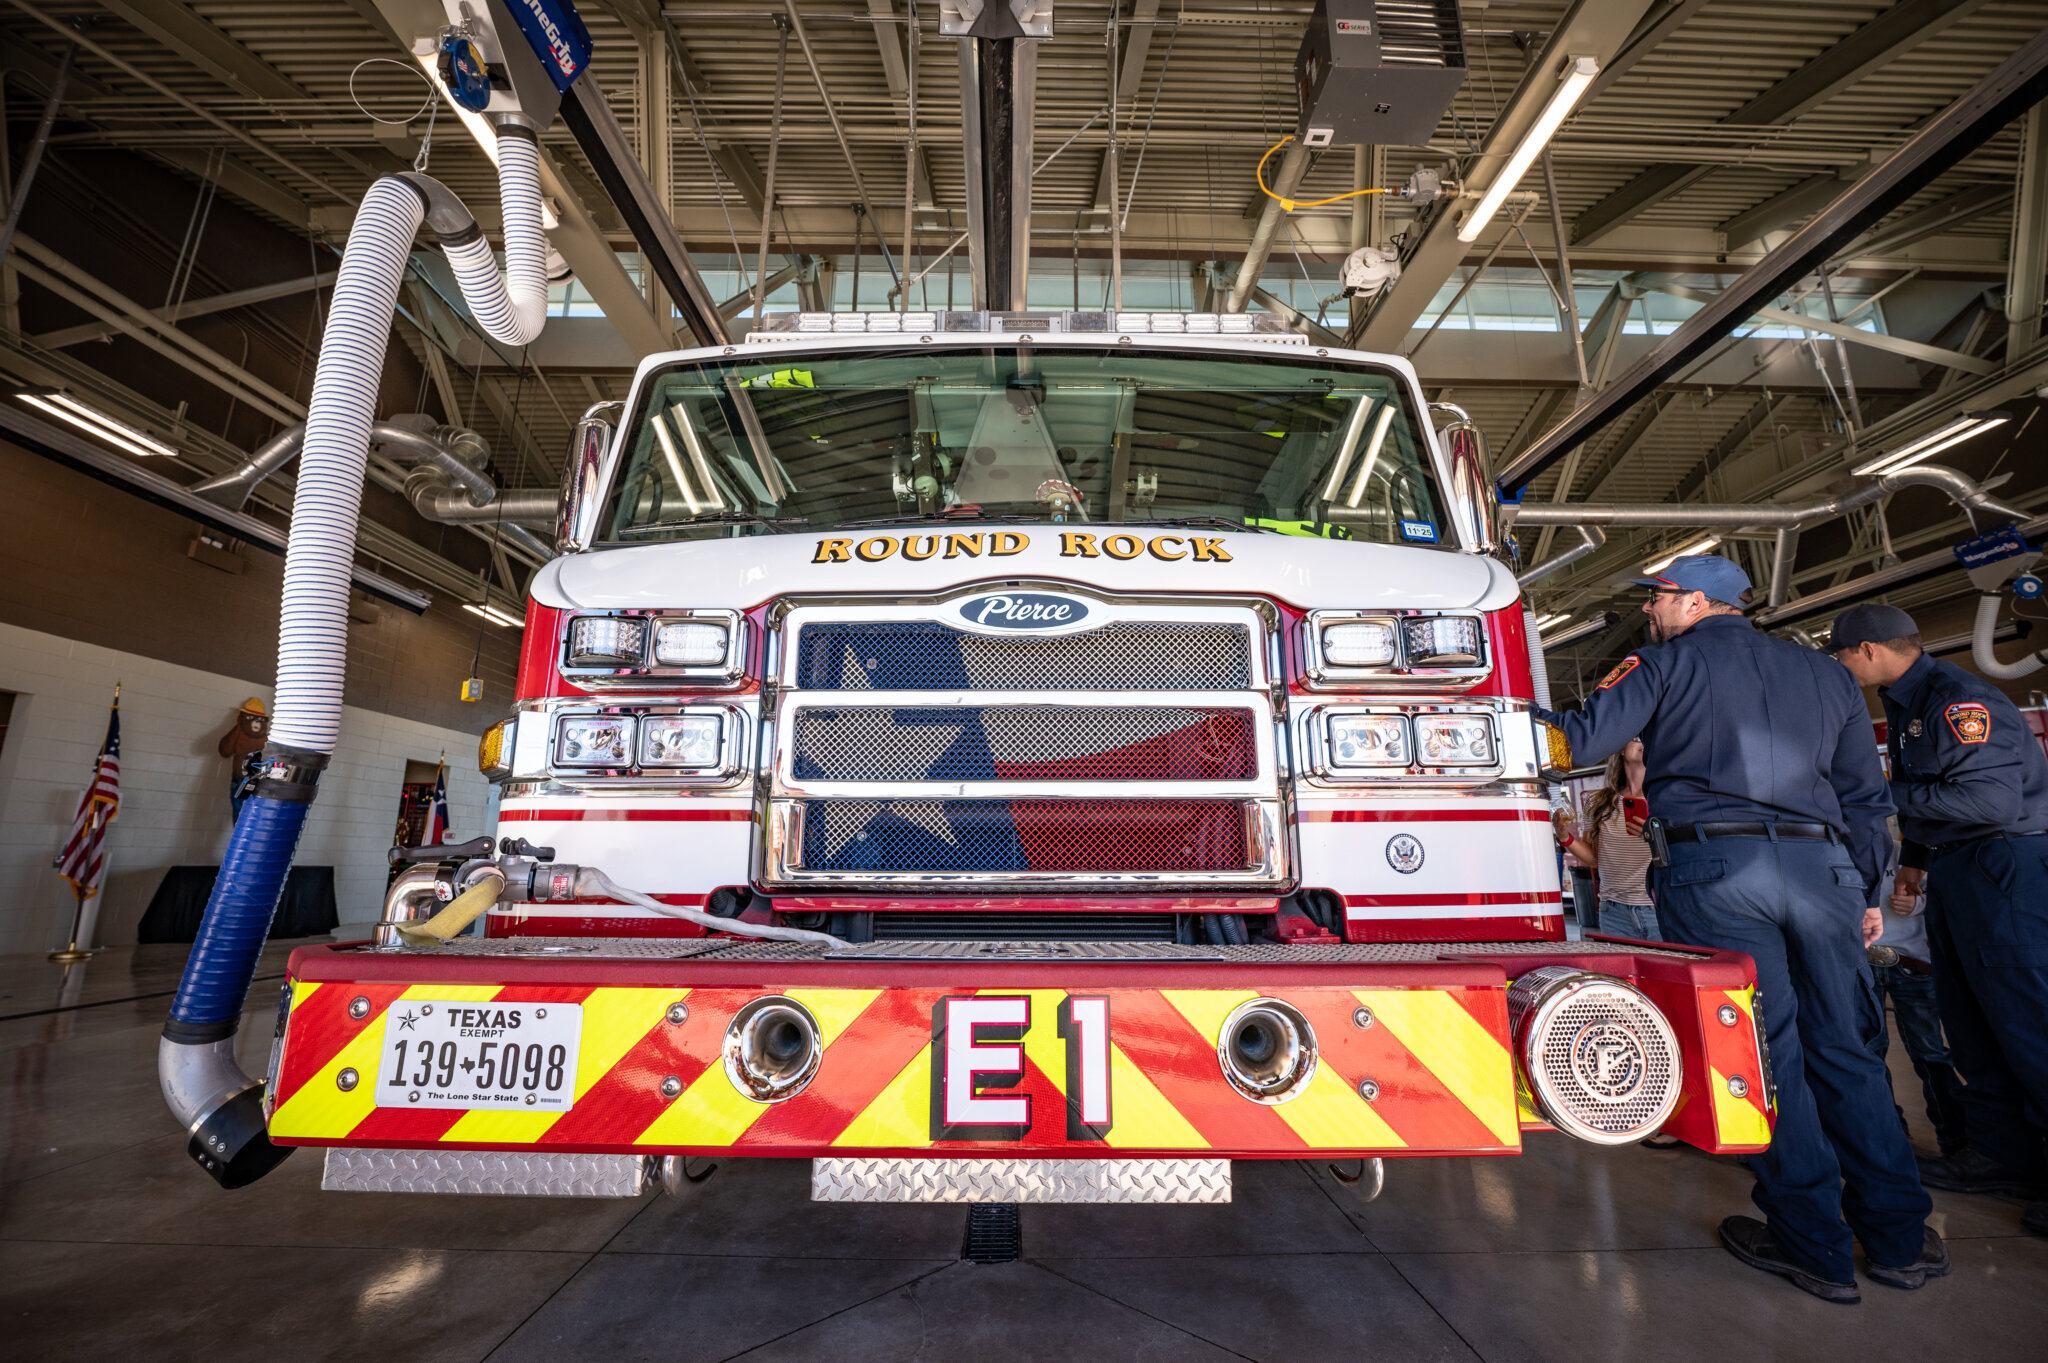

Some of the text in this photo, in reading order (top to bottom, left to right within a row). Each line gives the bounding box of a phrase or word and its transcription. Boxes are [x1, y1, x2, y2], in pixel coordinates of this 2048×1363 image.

[811, 531, 1234, 563] ROUND ROCK
[977, 594, 1072, 624] Pierce
[447, 1008, 522, 1029] TEXAS
[459, 1029, 505, 1039] EXEMPT
[427, 1092, 445, 1100] The
[472, 1093, 492, 1101] Star
[494, 1094, 519, 1102] State
